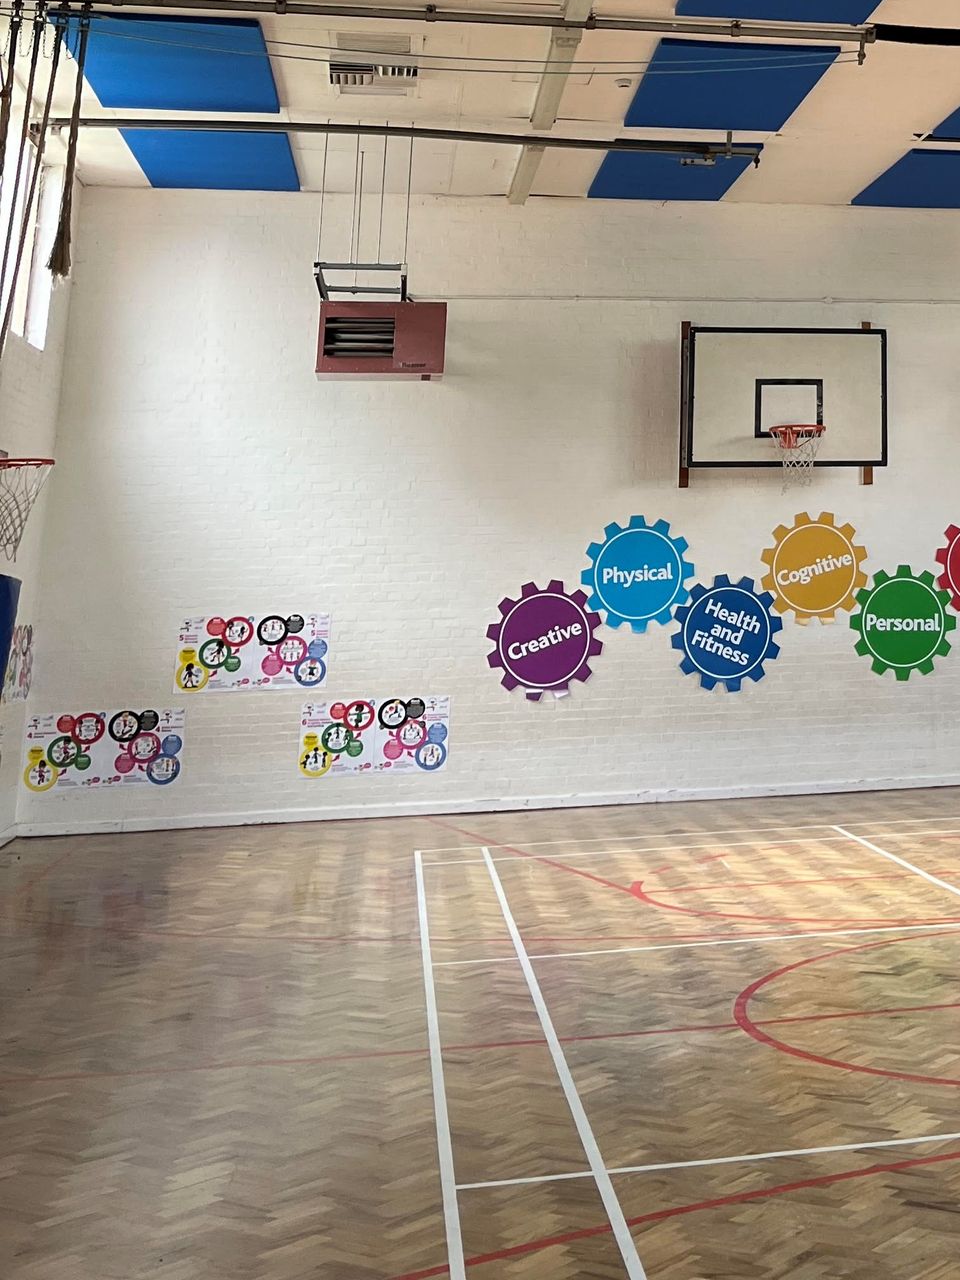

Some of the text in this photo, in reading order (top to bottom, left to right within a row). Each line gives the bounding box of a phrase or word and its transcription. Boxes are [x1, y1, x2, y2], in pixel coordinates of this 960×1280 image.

[602, 563, 673, 588] Physical
[776, 553, 852, 585] Cognitive
[704, 599, 761, 634] Health
[866, 613, 941, 631] Personal
[507, 623, 582, 660] Creative
[691, 629, 750, 666] Fitness
[710, 622, 744, 644] and
